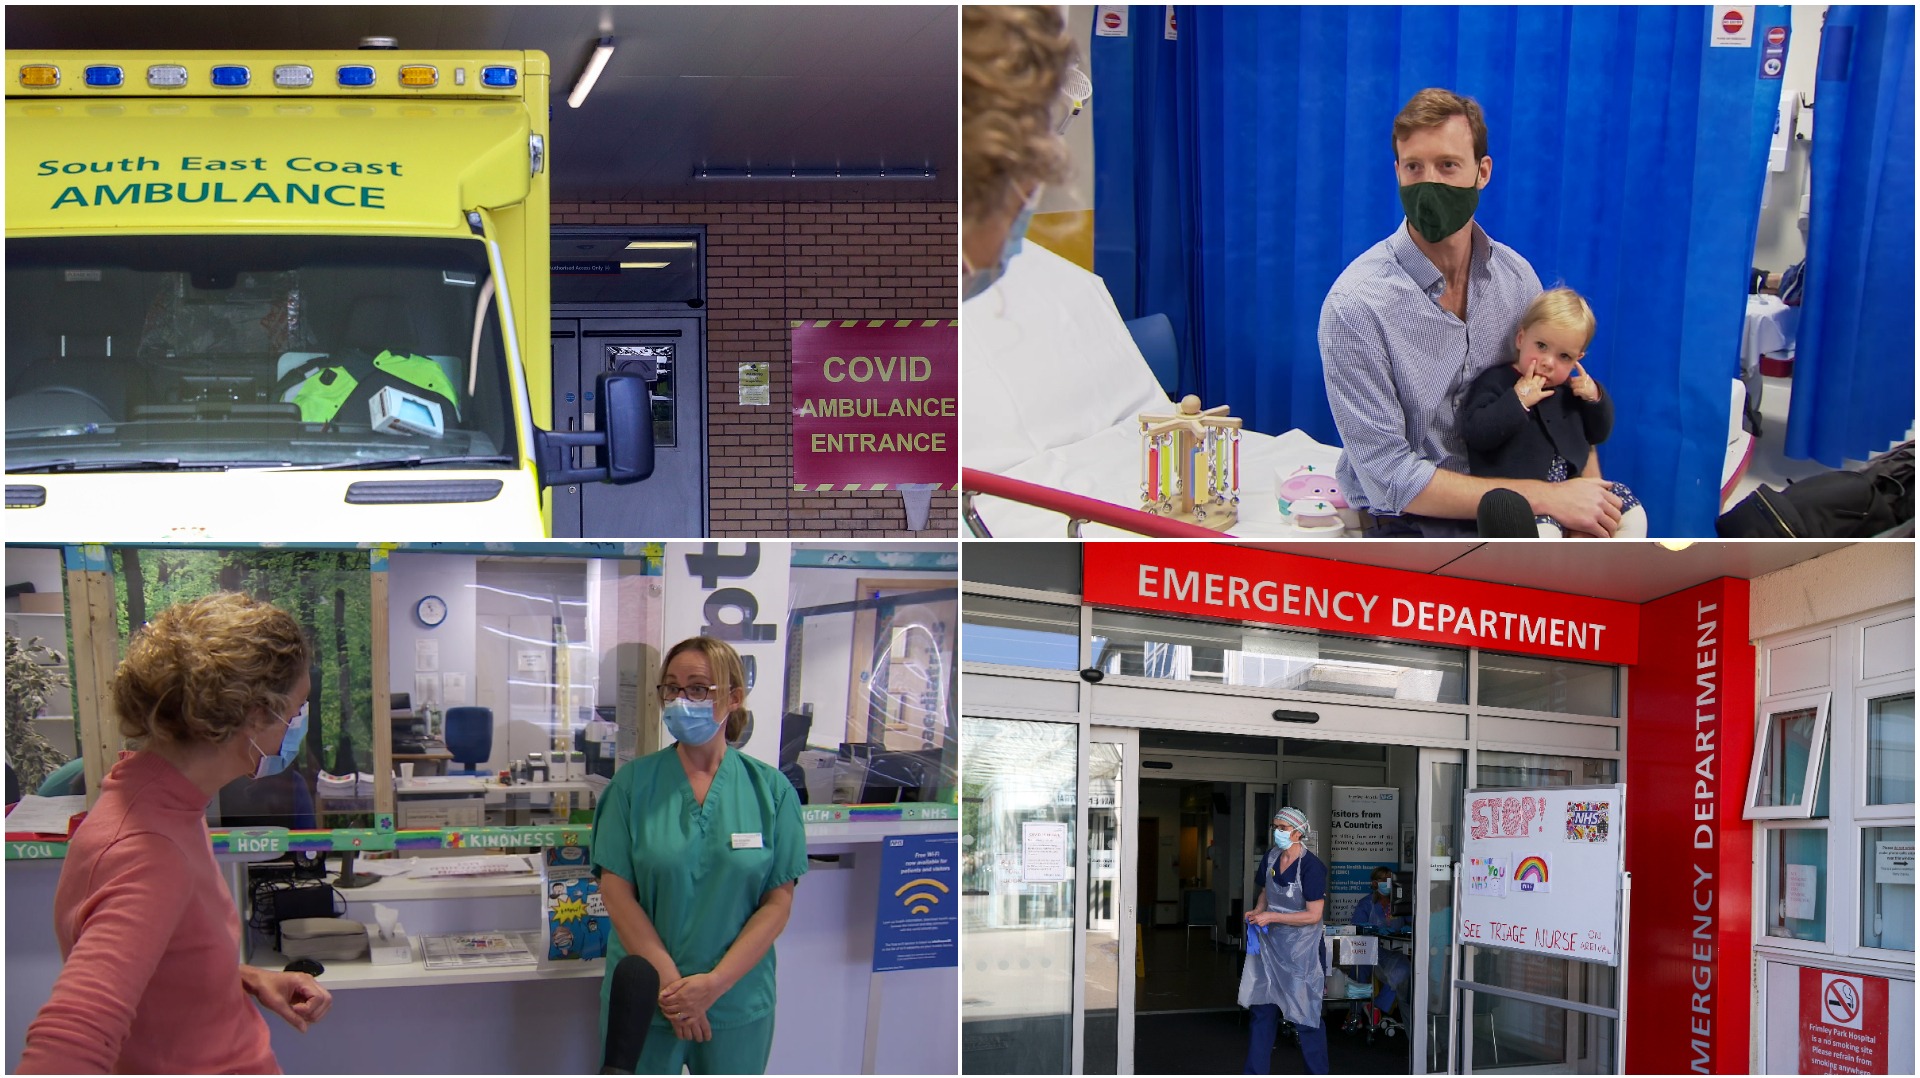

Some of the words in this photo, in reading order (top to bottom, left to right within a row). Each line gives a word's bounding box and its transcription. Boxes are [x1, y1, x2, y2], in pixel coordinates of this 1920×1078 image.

[37, 156, 160, 177] South
[181, 156, 268, 172] East
[286, 156, 404, 177] Coast
[51, 182, 386, 210] AMBULANCE
[823, 356, 932, 383] COVID
[800, 397, 957, 419] AMBULANCE
[811, 432, 947, 453] ENTRANCE
[1138, 564, 1380, 624] EMERGENCY
[1391, 598, 1607, 652] DEPARTMENT
[1694, 600, 1718, 849] DEPARTMENT
[921, 808, 948, 819] NHS
[1361, 810, 1382, 818] from
[1471, 796, 1546, 840] STOP!
[1574, 812, 1598, 824] NHS
[1344, 821, 1383, 829] Countries
[237, 838, 280, 852] HOPE
[470, 832, 556, 848] KINDNESS
[13, 843, 52, 858] YOU
[1488, 865, 1506, 878] YOU
[1464, 920, 1482, 938] SEE
[1490, 922, 1528, 944] TRIAGE
[1535, 928, 1578, 952] NURSE
[1691, 863, 1713, 1075] MERGENCY
[1810, 1024, 1832, 1036] Frimley
[1834, 1028, 1847, 1037] Park
[1849, 1032, 1876, 1044] Hospital
[1812, 1046, 1832, 1056] Please
[1834, 1051, 1854, 1062] refrain
[1856, 1056, 1872, 1066] from
[1833, 1040, 1860, 1053] smoking
[1861, 1045, 1873, 1054] site
[1812, 1058, 1837, 1070] smoking
[1839, 1063, 1871, 1075] anywhere
